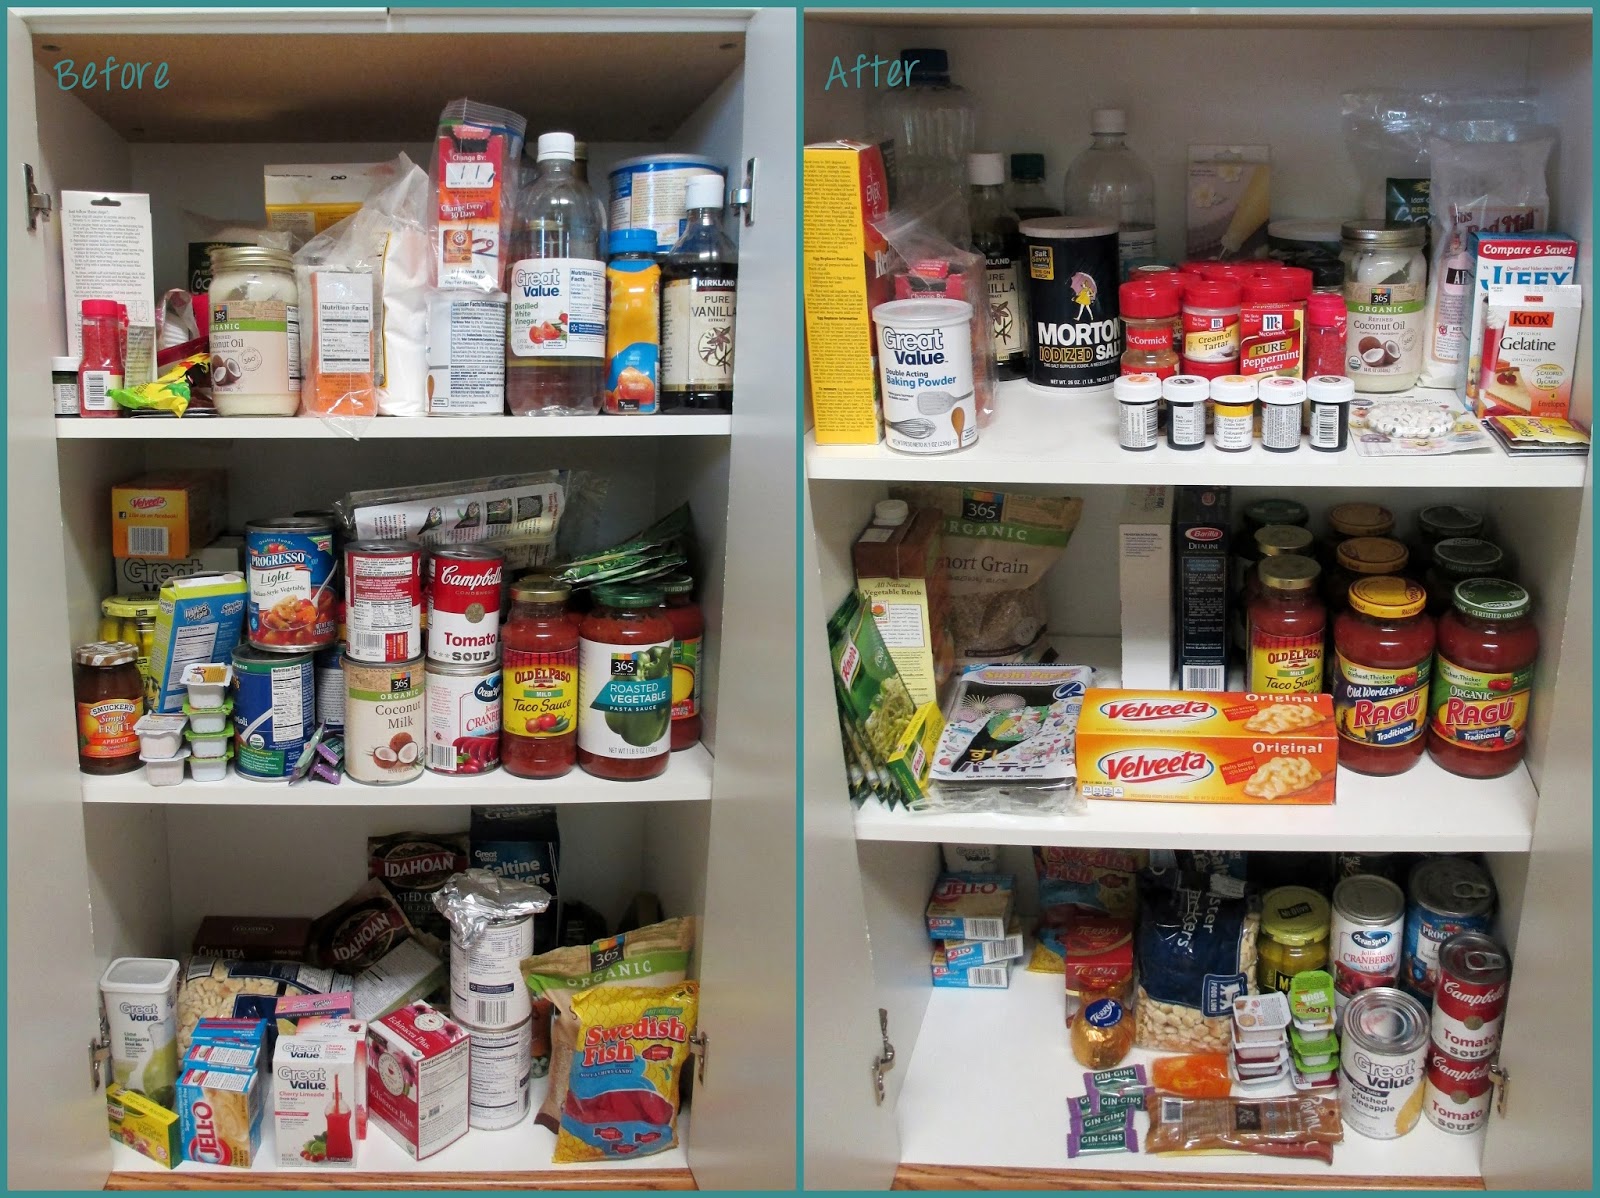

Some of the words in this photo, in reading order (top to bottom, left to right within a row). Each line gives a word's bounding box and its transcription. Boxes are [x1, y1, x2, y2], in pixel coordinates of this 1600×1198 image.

[452, 154, 476, 162] Change
[441, 204, 465, 212] Change
[466, 203, 484, 211] Every
[460, 211, 475, 219] Days
[1482, 244, 1531, 256] Compare
[1533, 245, 1543, 255] &
[1544, 244, 1573, 255] Save!
[515, 268, 560, 286] Great
[699, 279, 735, 287] KIRKLAND
[523, 286, 560, 297] Value
[704, 295, 730, 304] PURE
[1373, 294, 1388, 303] 365
[514, 302, 539, 310] Distilled
[691, 306, 737, 318] VANILLA
[1358, 305, 1404, 313] ORGANIC
[214, 310, 228, 322] 365
[514, 318, 538, 326] Vinegar
[1513, 312, 1549, 325] Knox
[210, 322, 240, 331] RGANIC
[1353, 320, 1391, 330] Coconut
[1392, 320, 1406, 330] Oil
[881, 326, 945, 351] Great
[1037, 319, 1121, 346] MORTON
[1197, 333, 1224, 345] Cream
[1224, 329, 1233, 338] of
[1258, 330, 1287, 338] McCormick
[231, 339, 244, 349] Oil
[1126, 334, 1168, 345] McCormick
[1203, 339, 1229, 351] Tartar
[1500, 337, 1556, 351] Gelatine
[1039, 347, 1094, 363] IODIZED
[1096, 339, 1121, 360] SALT
[1254, 341, 1287, 356] PURE
[894, 350, 945, 365] Value
[1242, 350, 1300, 368] Peppermint
[885, 368, 904, 377] Double
[905, 369, 929, 378] Acting
[1258, 364, 1283, 373] EXTRACT
[886, 375, 917, 389] Baking
[917, 375, 957, 388] Powder
[132, 496, 166, 508] Velveeta
[968, 503, 996, 518] 365
[945, 521, 1028, 541] RGANIC
[251, 552, 305, 567] PROGRESSO
[943, 556, 978, 571] hort
[981, 555, 1029, 574] Grain
[124, 557, 202, 584] Great
[260, 570, 292, 585] Light
[441, 565, 502, 591] Campbell
[280, 584, 306, 594] Vegetable
[1472, 610, 1501, 619] CERTIFIED
[444, 632, 496, 647] Tomato
[452, 651, 490, 661] SOUP
[1267, 651, 1287, 665] OLD
[1289, 649, 1302, 661] EL
[614, 661, 635, 673] 365
[841, 647, 857, 681] Knorr
[514, 669, 534, 684] OLD
[535, 667, 549, 680] EL
[983, 670, 1025, 680] Sushi
[1264, 676, 1292, 690] Taco
[1294, 672, 1321, 689] Sauce
[1460, 675, 1482, 683] Thicker
[393, 680, 408, 690] 365
[610, 682, 659, 693] ROASTED
[1346, 685, 1361, 697] Old
[1362, 686, 1389, 698] World
[1388, 685, 1406, 696] Style
[380, 690, 419, 700] ORGANIC
[610, 690, 667, 704] VEGETABLE
[1245, 693, 1319, 704] Original
[1450, 685, 1494, 700] ORGANIC
[92, 703, 135, 715] SMUCKER'S
[375, 701, 421, 716] Coconut
[513, 697, 539, 712] Taco
[540, 698, 572, 713] Sauce
[635, 704, 657, 712] SAUCE
[1106, 700, 1211, 720] Velveeta
[99, 713, 127, 725] Simply
[388, 716, 414, 729] Milk
[466, 710, 499, 731] CRANBE
[98, 722, 130, 734] FRUIT
[1377, 723, 1414, 742] Traditional
[102, 737, 129, 745] APRICOT
[1464, 731, 1501, 741] Traditional
[1252, 741, 1323, 755] Original
[1106, 750, 1207, 780] Velveeta
[1237, 760, 1254, 768] better
[474, 850, 498, 858] Great
[384, 856, 454, 878] IDAHOAN
[332, 912, 391, 962] IDAHOAN
[226, 949, 246, 959] TEA
[596, 948, 620, 966] 365
[1343, 953, 1395, 966] CRANBERRY
[566, 960, 652, 988] ORGANIC
[119, 1002, 158, 1015] Great
[129, 1013, 159, 1022] Value
[387, 1015, 416, 1039] Echinacea
[586, 1017, 687, 1047] Swedish
[1443, 1029, 1496, 1048] Tomato
[282, 1043, 322, 1053] Great
[581, 1040, 636, 1068] Fish
[1450, 1047, 1487, 1057] SOUP
[290, 1051, 320, 1059] Value
[420, 1048, 454, 1067] Supplement
[1353, 1052, 1416, 1078] Great
[277, 1065, 327, 1081] Great
[289, 1080, 327, 1090] Value
[1366, 1074, 1414, 1089] Value
[369, 1084, 399, 1117] Echinacea
[1351, 1088, 1388, 1105] Crushed
[1351, 1095, 1396, 1112] Pineapple
[1432, 1100, 1483, 1121] Tomato
[1437, 1118, 1475, 1131] SOUP
